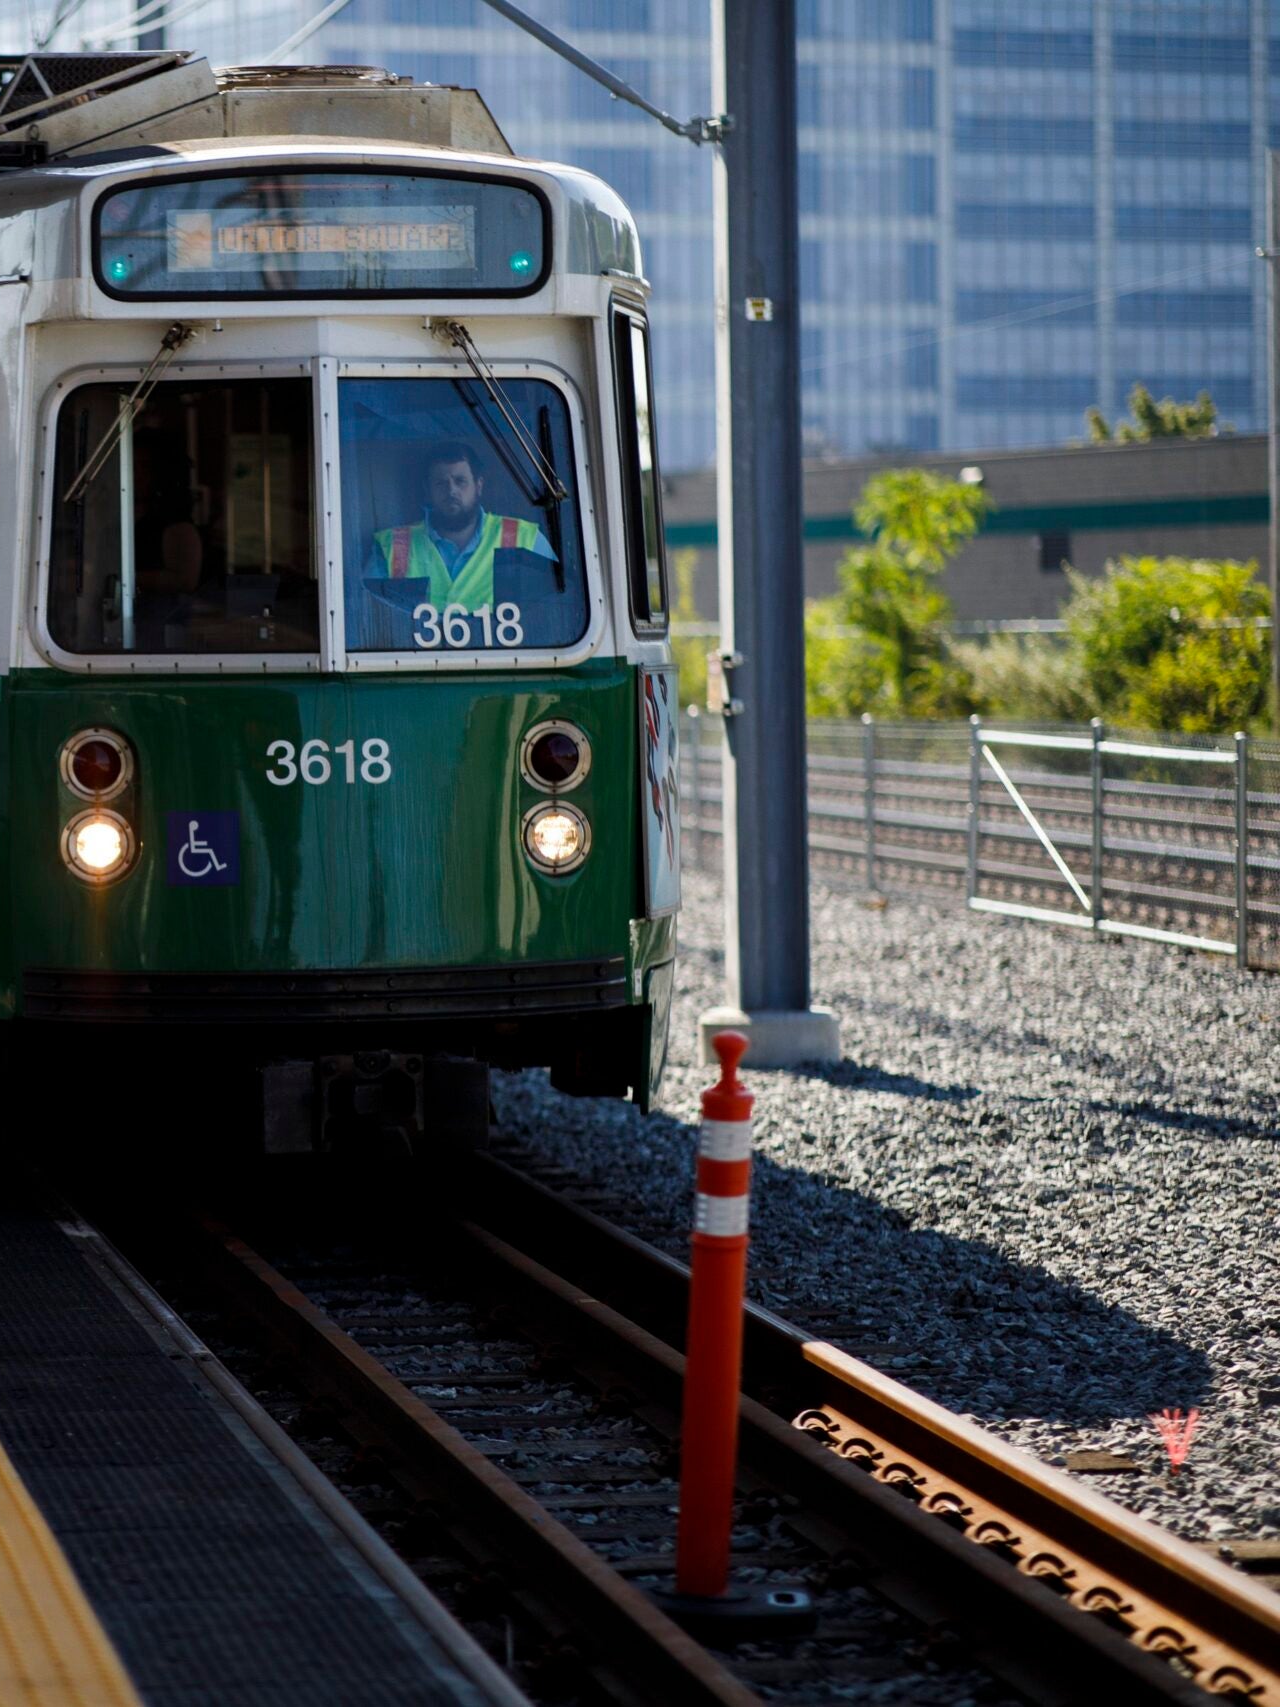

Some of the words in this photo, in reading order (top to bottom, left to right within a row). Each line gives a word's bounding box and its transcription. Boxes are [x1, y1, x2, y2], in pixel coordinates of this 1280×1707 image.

[220, 227, 320, 251] UNION
[346, 224, 463, 250] SQUARE
[412, 603, 524, 648] 3618
[265, 738, 391, 785] 3618
